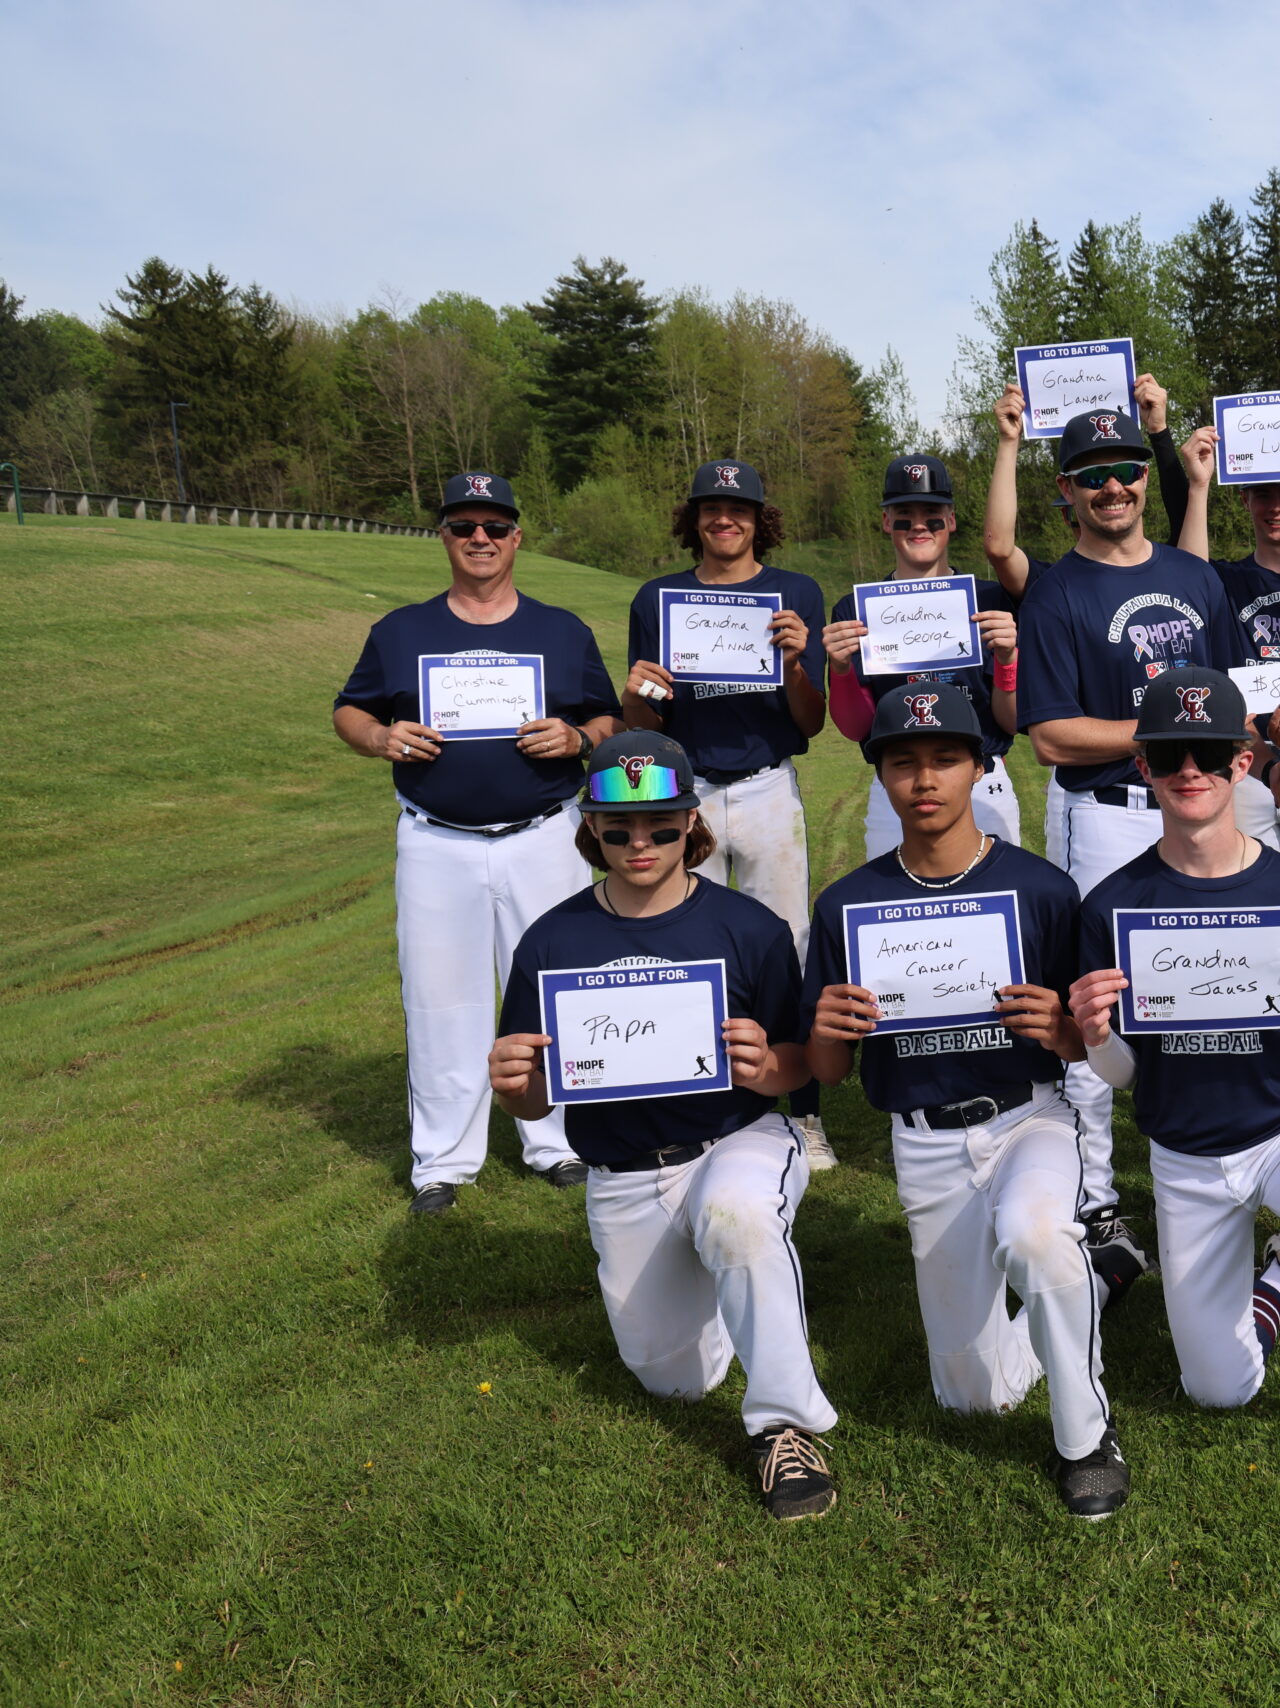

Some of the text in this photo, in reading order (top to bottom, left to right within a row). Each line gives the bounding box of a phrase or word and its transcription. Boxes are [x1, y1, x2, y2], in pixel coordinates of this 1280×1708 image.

[1071, 347, 1087, 355] BAT
[1090, 345, 1109, 353] FOR:
[1043, 370, 1107, 388] Grandma
[1064, 392, 1111, 408] Langer
[912, 583, 929, 591] BAT
[738, 597, 757, 605] FOR:
[686, 613, 749, 631] Grandma
[881, 606, 946, 624] Grandma
[1108, 593, 1204, 643] CHAUTAUQUA LAKE
[903, 630, 956, 648] George
[1146, 620, 1193, 644] HOPE
[712, 635, 758, 653] Anna
[1155, 637, 1193, 658] AT BAT
[442, 672, 510, 689] Christine
[694, 683, 777, 699] BASEBALL
[453, 694, 527, 711] Cummings
[878, 902, 981, 919] I GO TO BAT FOR:
[1152, 914, 1260, 926] I GO TO BAT FOR:
[877, 938, 952, 958] American
[906, 959, 968, 976] Cancer
[1152, 947, 1250, 972] Grandma
[578, 970, 688, 986] I GO TO BAT FOR:
[933, 972, 996, 1001] Society
[1188, 976, 1257, 996] Jauss
[878, 994, 905, 1003] HOPE
[1149, 996, 1175, 1004] HOPE
[895, 1027, 1013, 1058] BASEBALL
[1162, 1032, 1263, 1055] BASEBALL
[576, 1060, 604, 1069] HOPE
